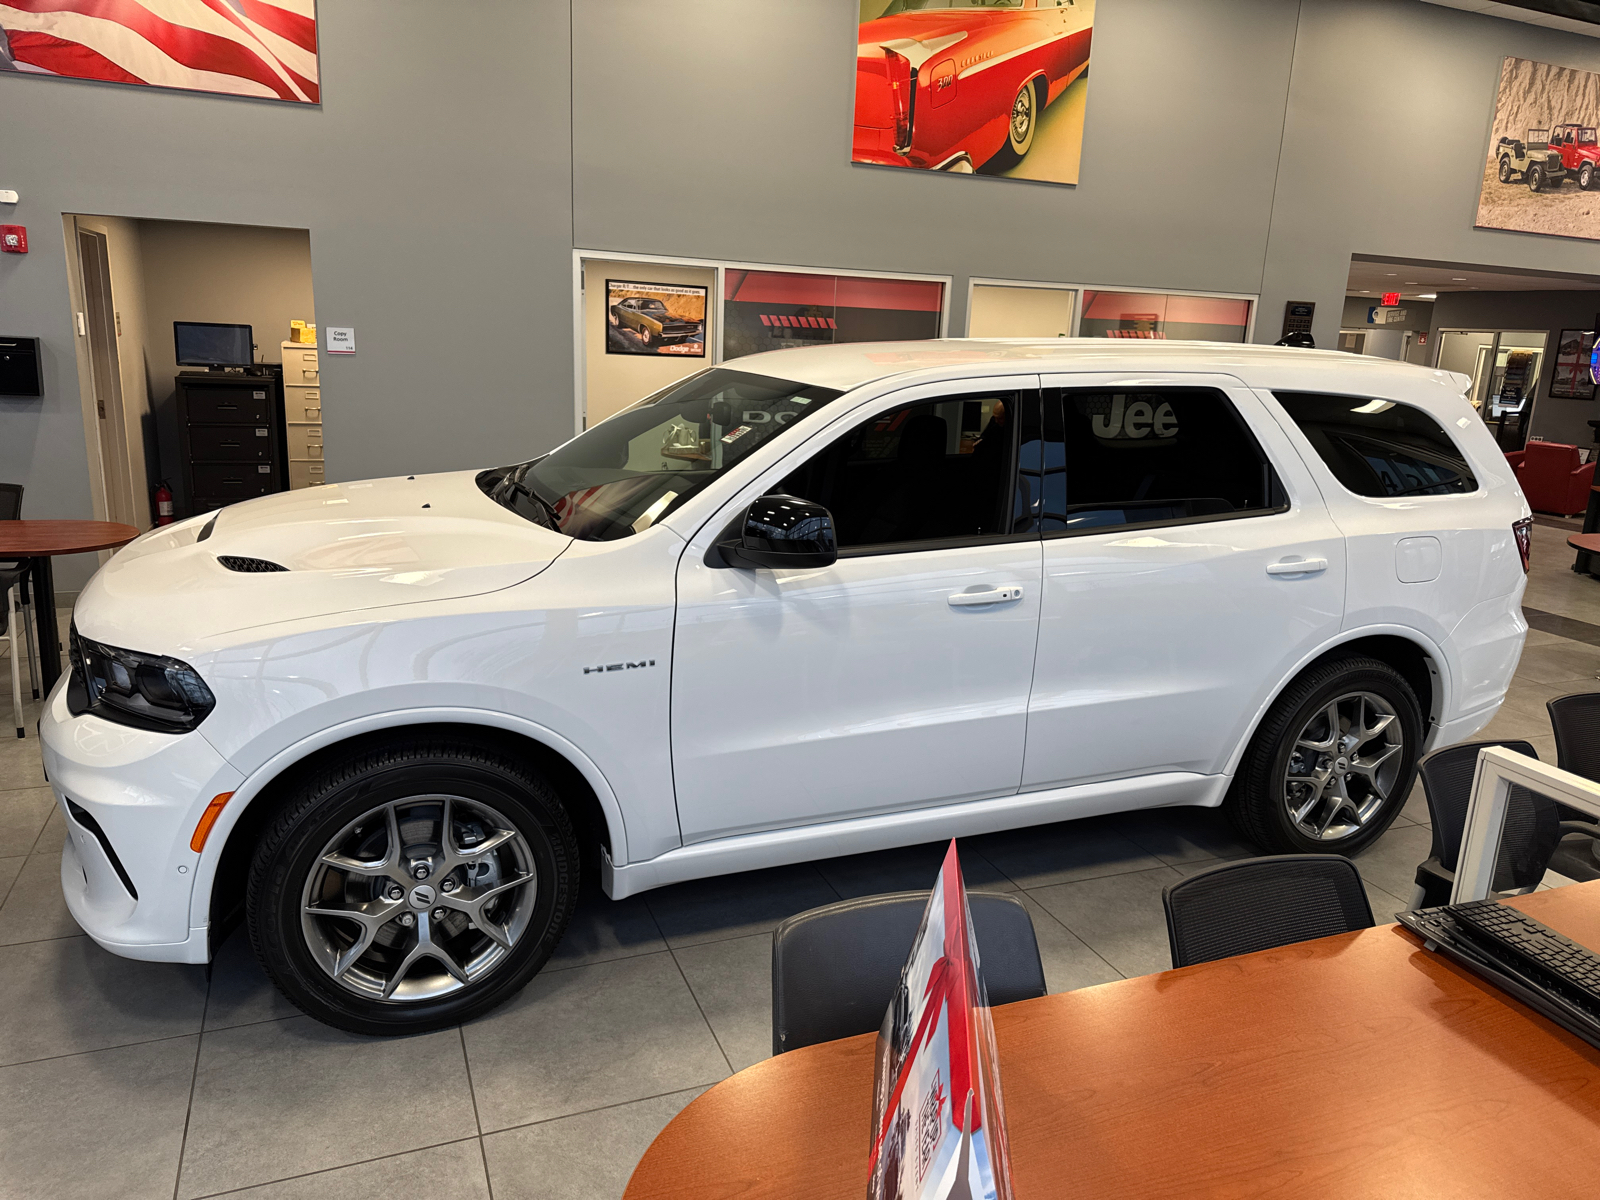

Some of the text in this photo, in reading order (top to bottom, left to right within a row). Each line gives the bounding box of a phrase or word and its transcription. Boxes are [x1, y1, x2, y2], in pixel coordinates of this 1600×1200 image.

[670, 345, 689, 353] Dodge
[583, 660, 655, 675] HEMI
[545, 832, 569, 944] BRIDGESTONE
